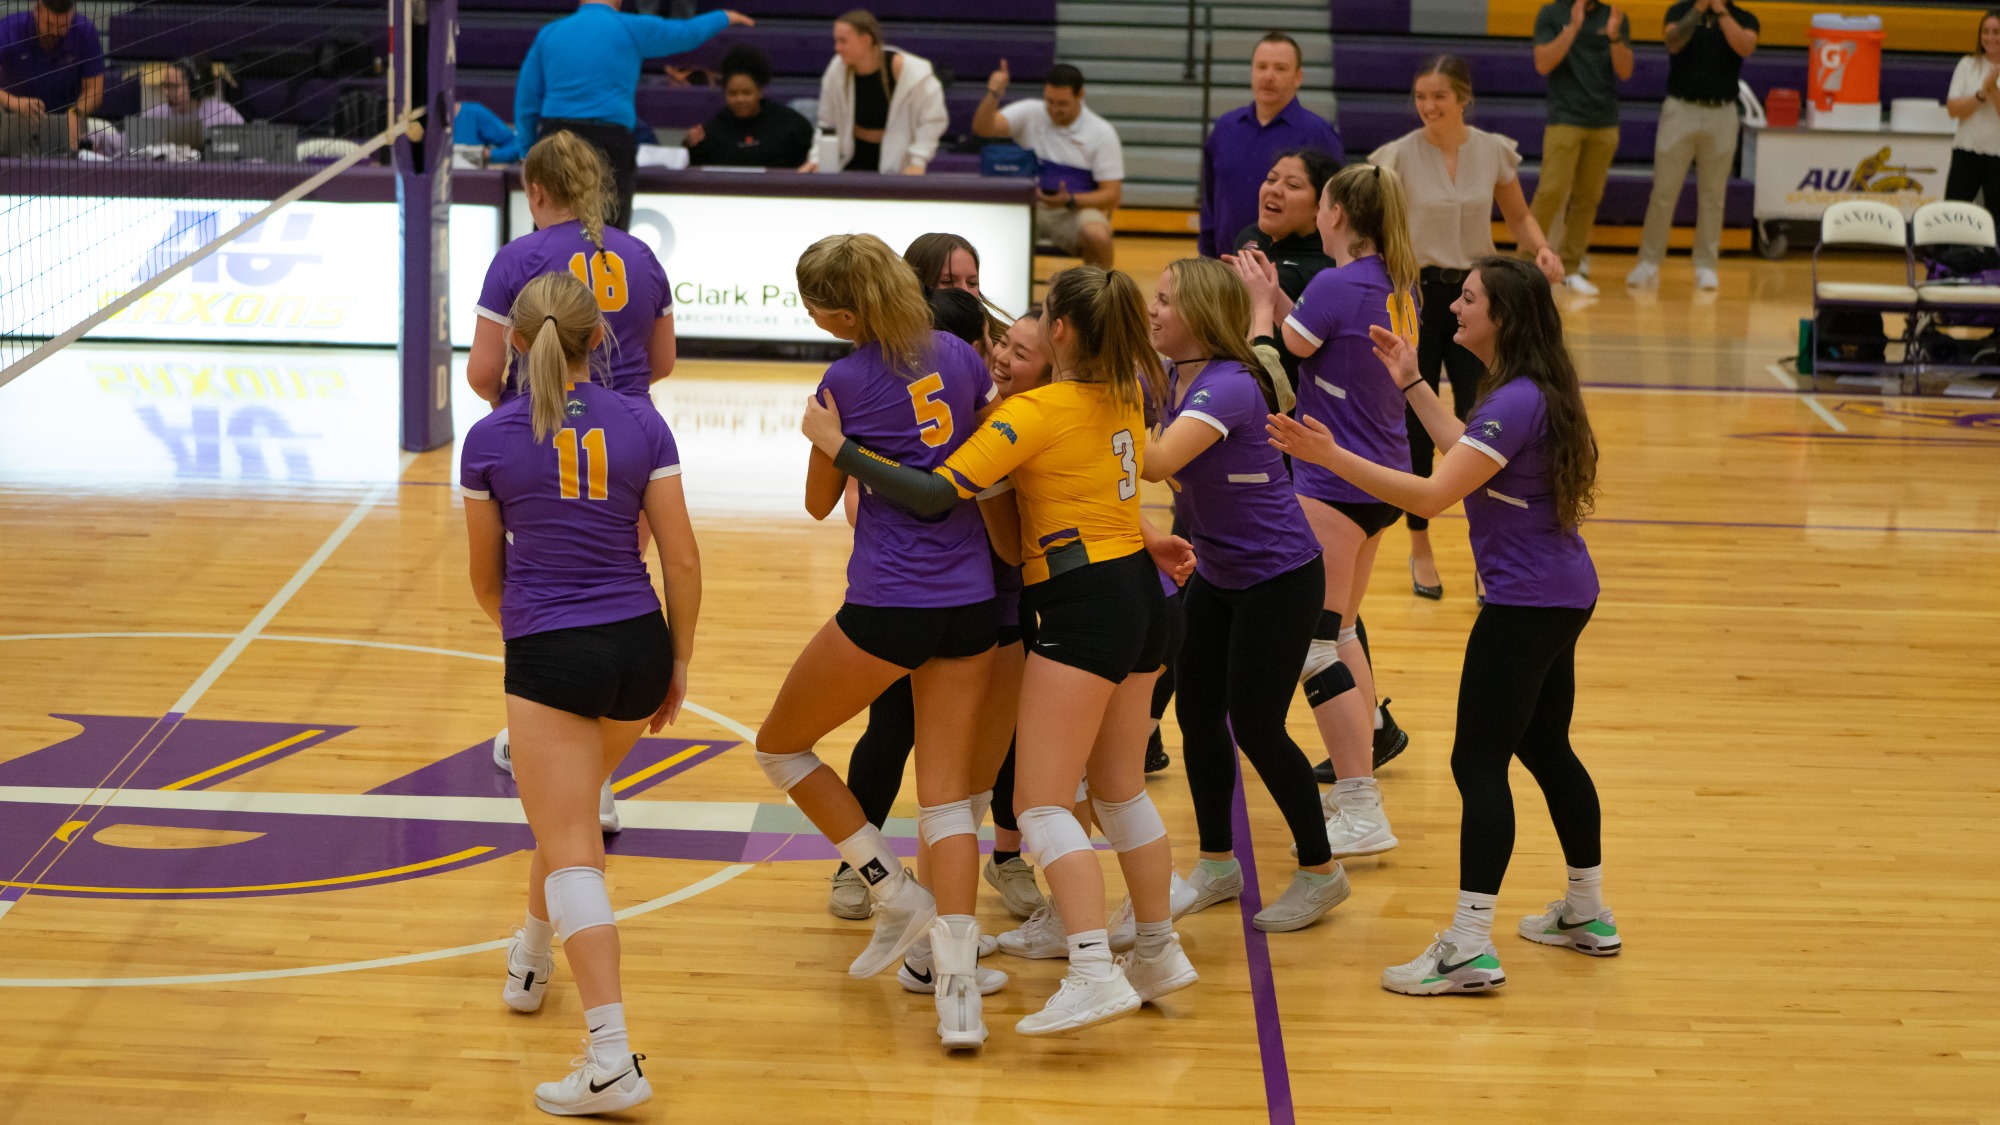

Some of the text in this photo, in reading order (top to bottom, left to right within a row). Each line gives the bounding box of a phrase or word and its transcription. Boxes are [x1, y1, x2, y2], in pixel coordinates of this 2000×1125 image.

[1797, 168, 1851, 192] AU
[674, 281, 749, 306] Clark
[907, 371, 954, 448] 5
[552, 426, 609, 500] 11
[1111, 428, 1138, 501] 3
